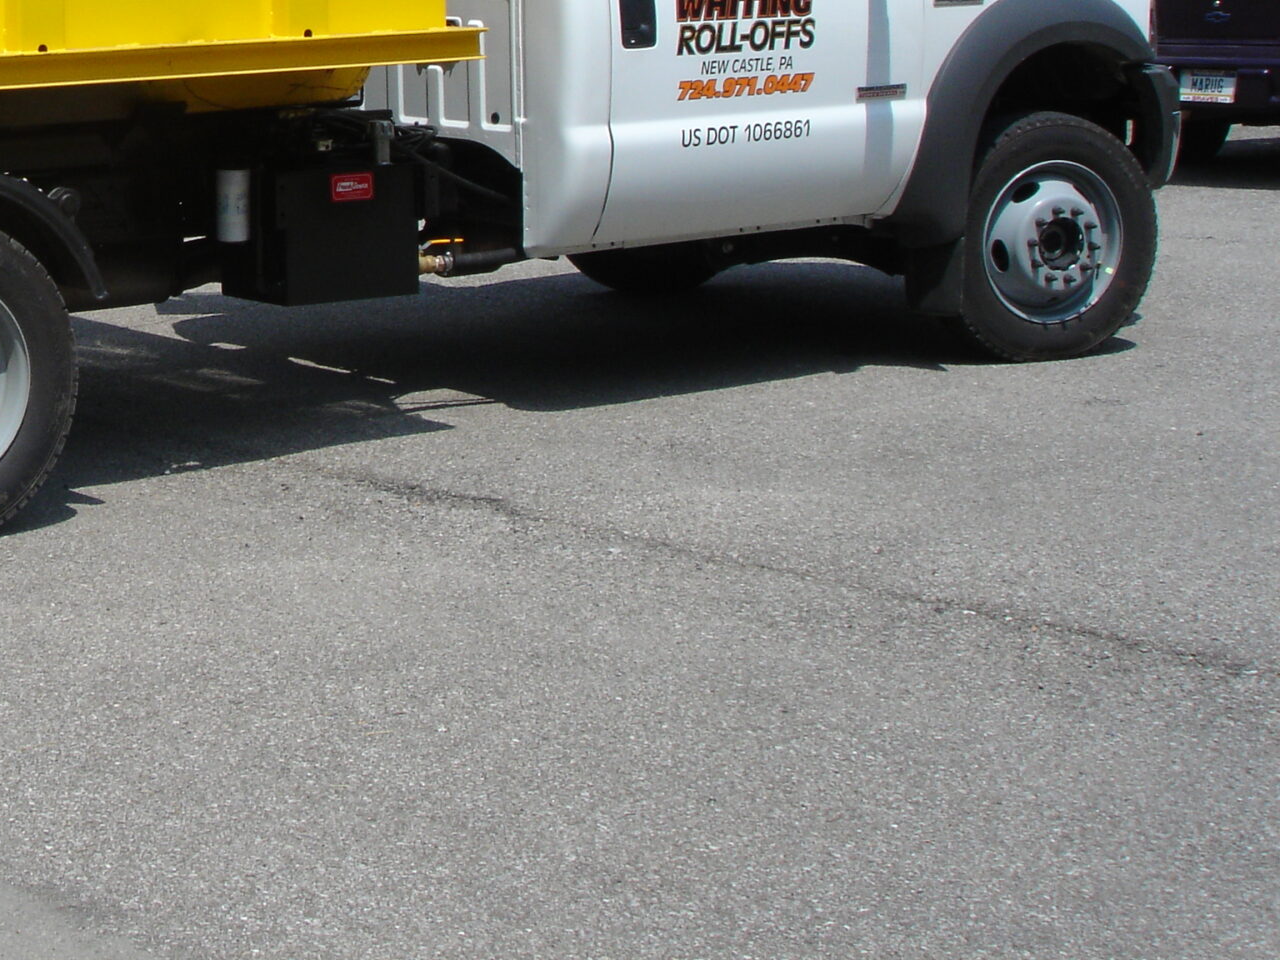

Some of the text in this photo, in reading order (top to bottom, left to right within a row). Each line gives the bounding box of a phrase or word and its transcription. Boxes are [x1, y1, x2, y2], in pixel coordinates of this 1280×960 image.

[676, 18, 816, 56] ROLL-OFFS
[701, 55, 793, 76] NEW CASTLE, PA
[677, 72, 816, 101] 724.971.0447
[681, 119, 811, 148] US DOT 1066861
